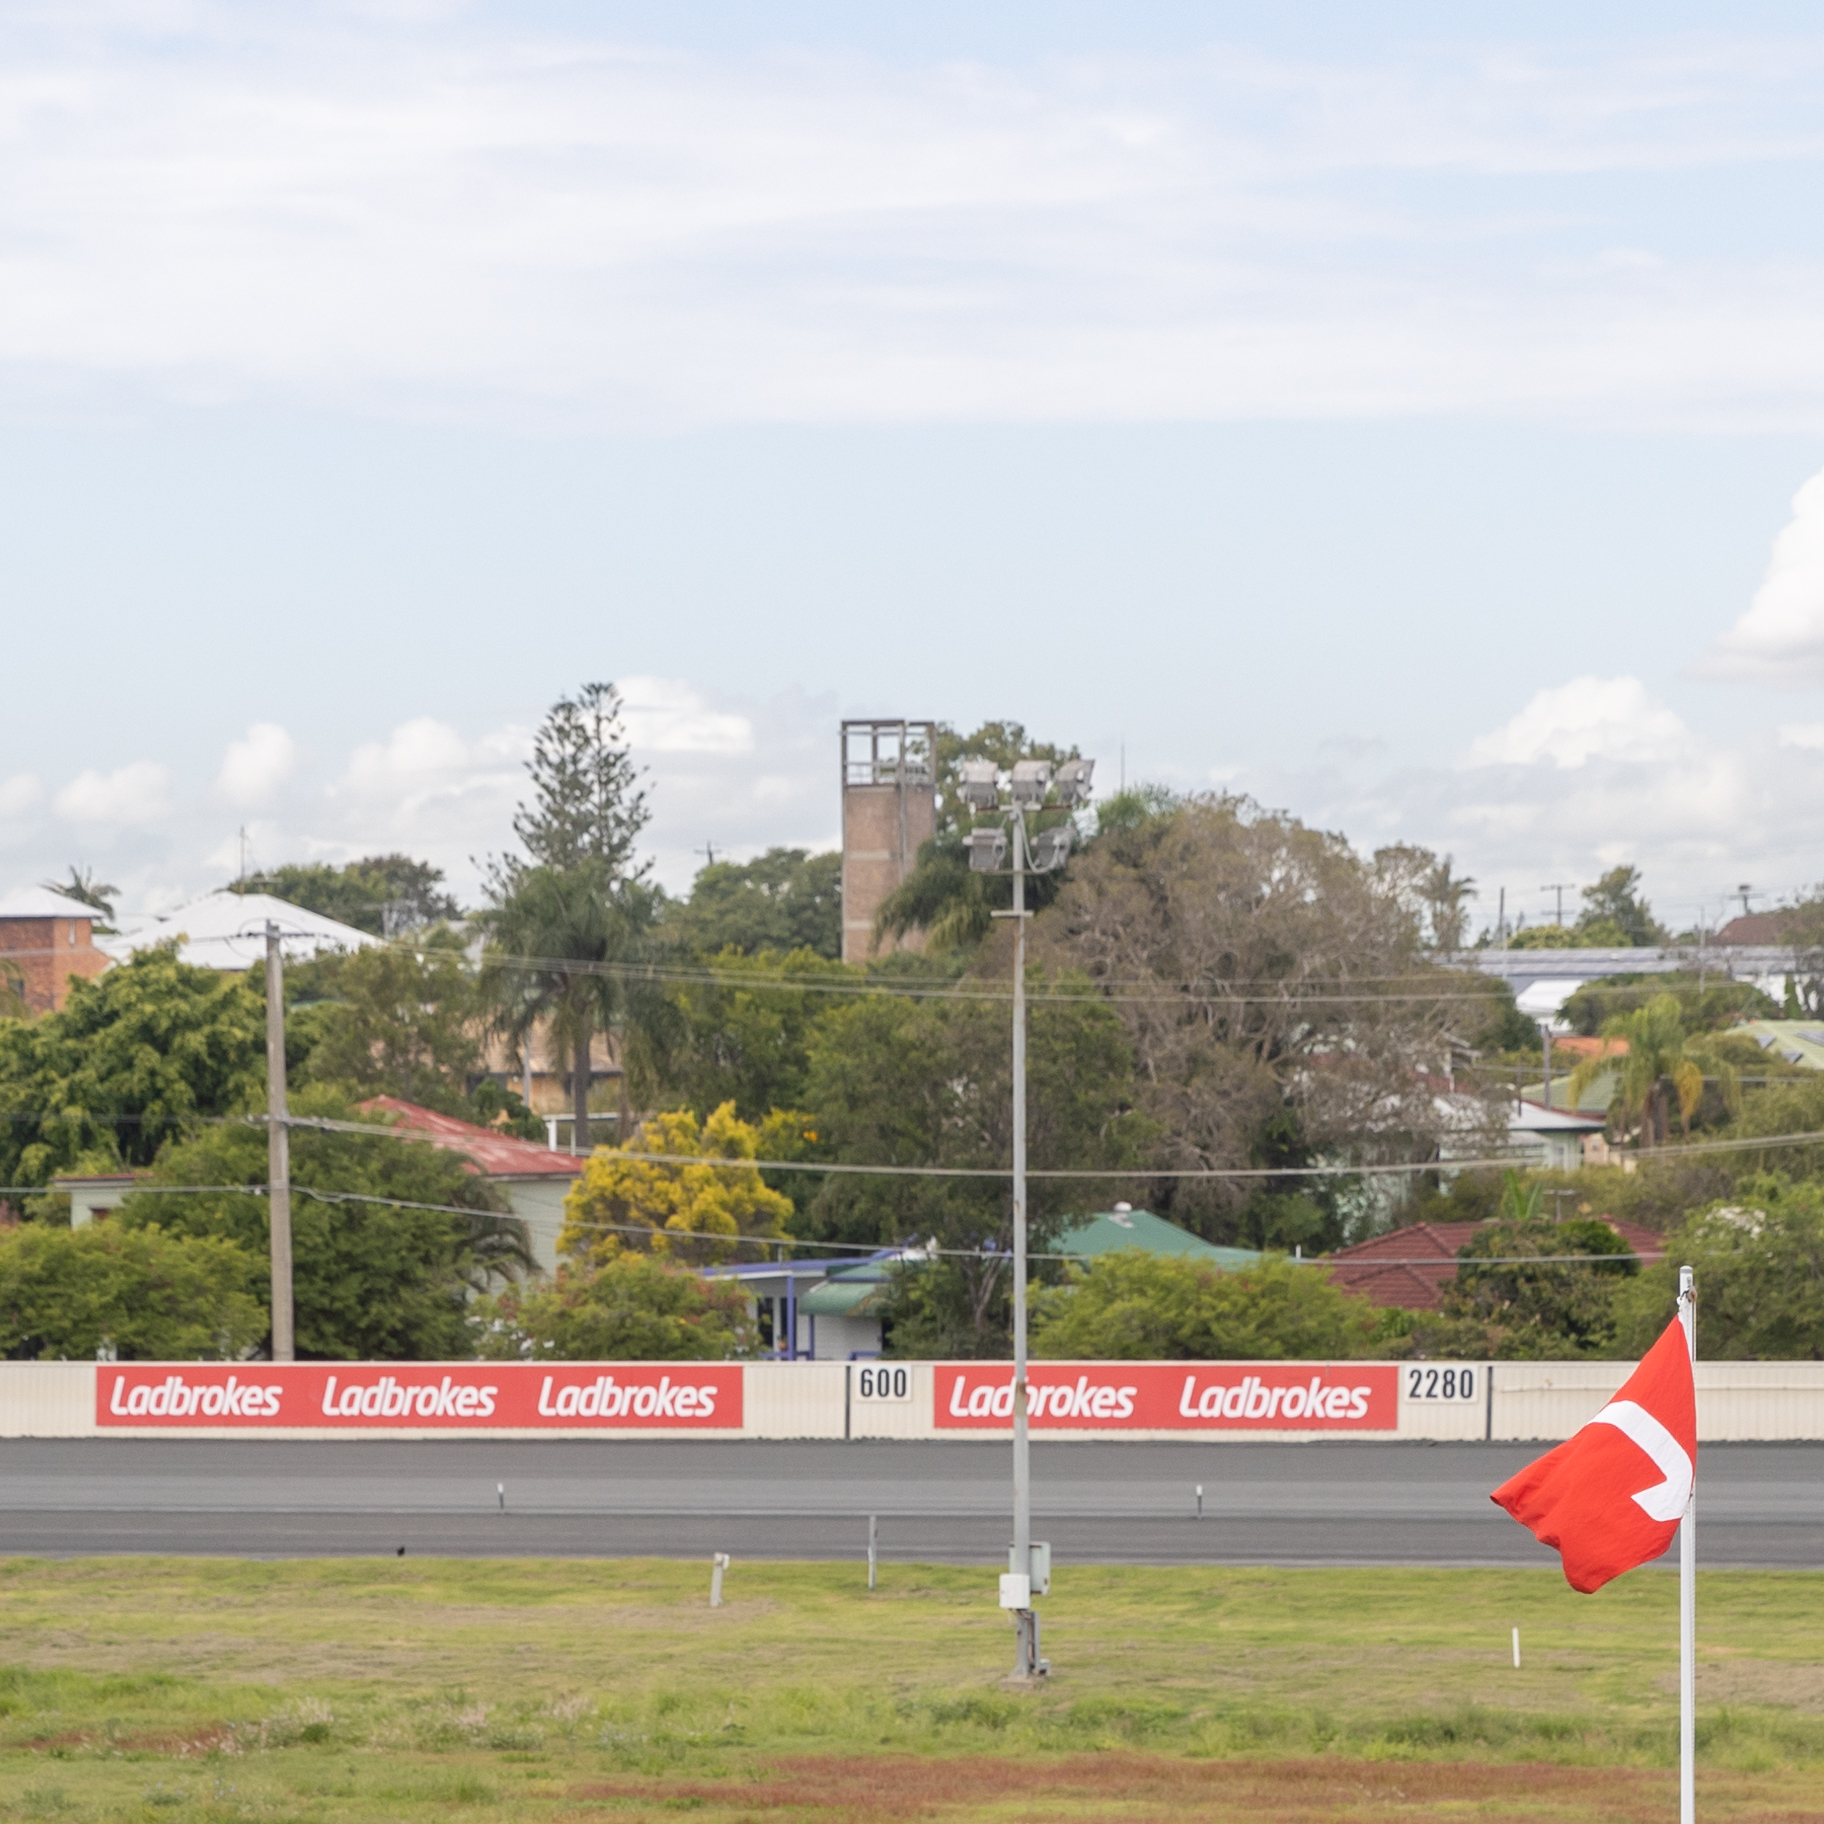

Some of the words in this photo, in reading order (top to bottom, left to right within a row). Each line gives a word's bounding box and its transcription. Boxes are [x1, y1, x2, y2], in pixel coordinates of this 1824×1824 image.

[110, 1375, 283, 1416] Ladbrokes
[321, 1376, 498, 1417] Ladbrokes
[537, 1376, 718, 1417] Ladbrokes
[860, 1368, 907, 1398] 600
[1179, 1375, 1372, 1419] Ladbrokes
[1409, 1369, 1473, 1399] 2280
